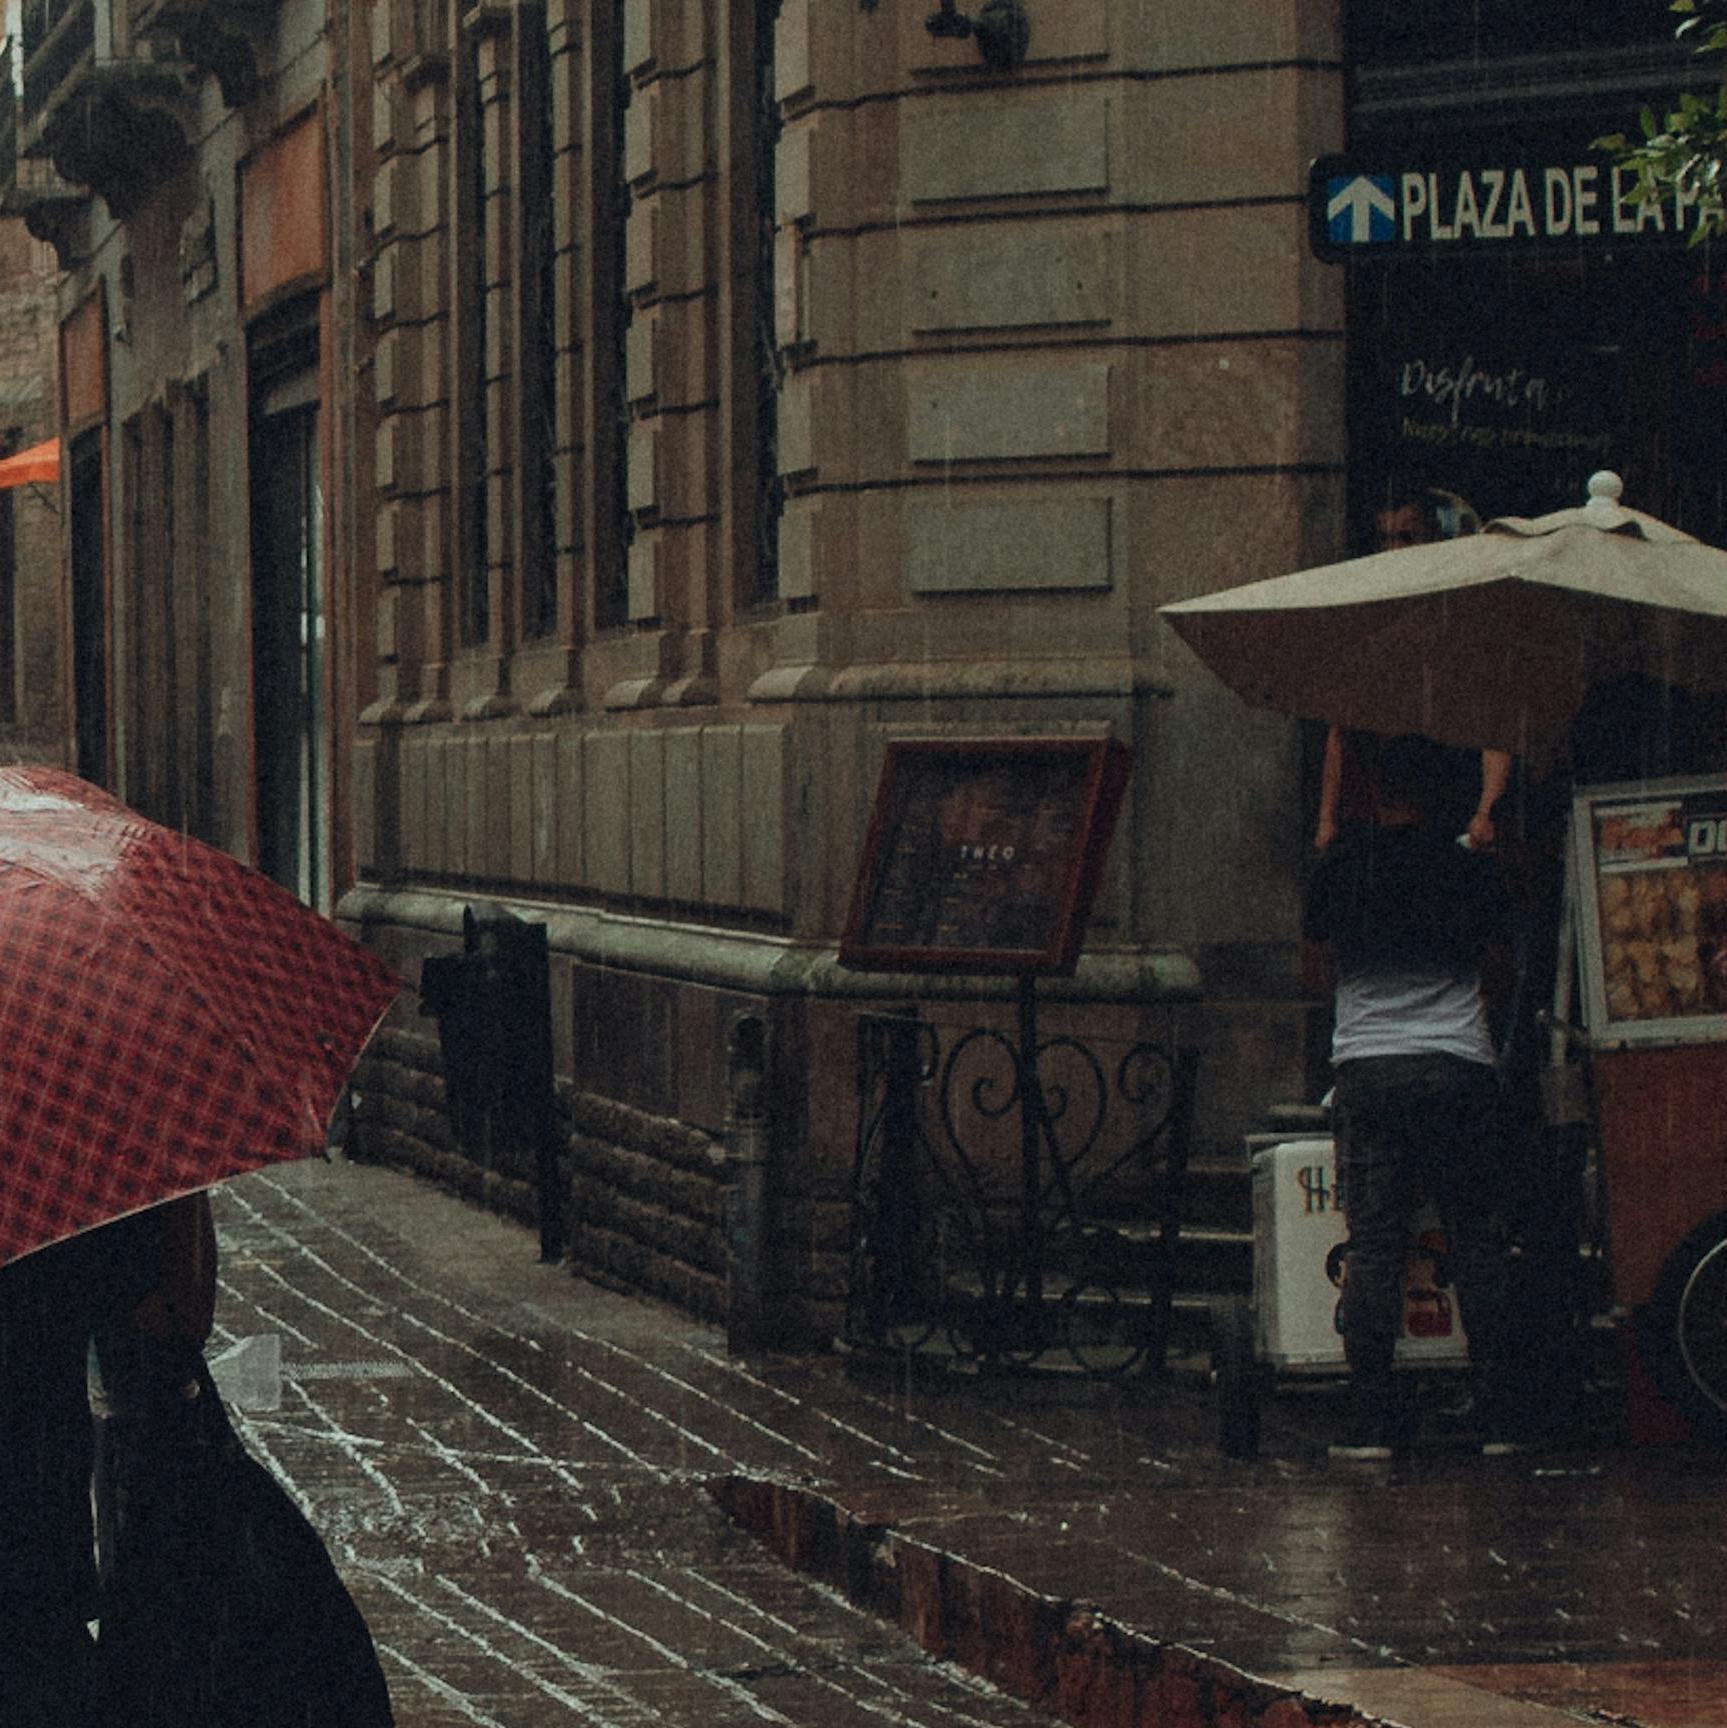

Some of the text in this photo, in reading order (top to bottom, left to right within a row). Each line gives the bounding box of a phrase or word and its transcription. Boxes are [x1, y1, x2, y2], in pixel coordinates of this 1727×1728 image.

[1401, 167, 1538, 242] PLAZA
[1543, 164, 1602, 237] DE
[1610, 164, 1666, 234] LA
